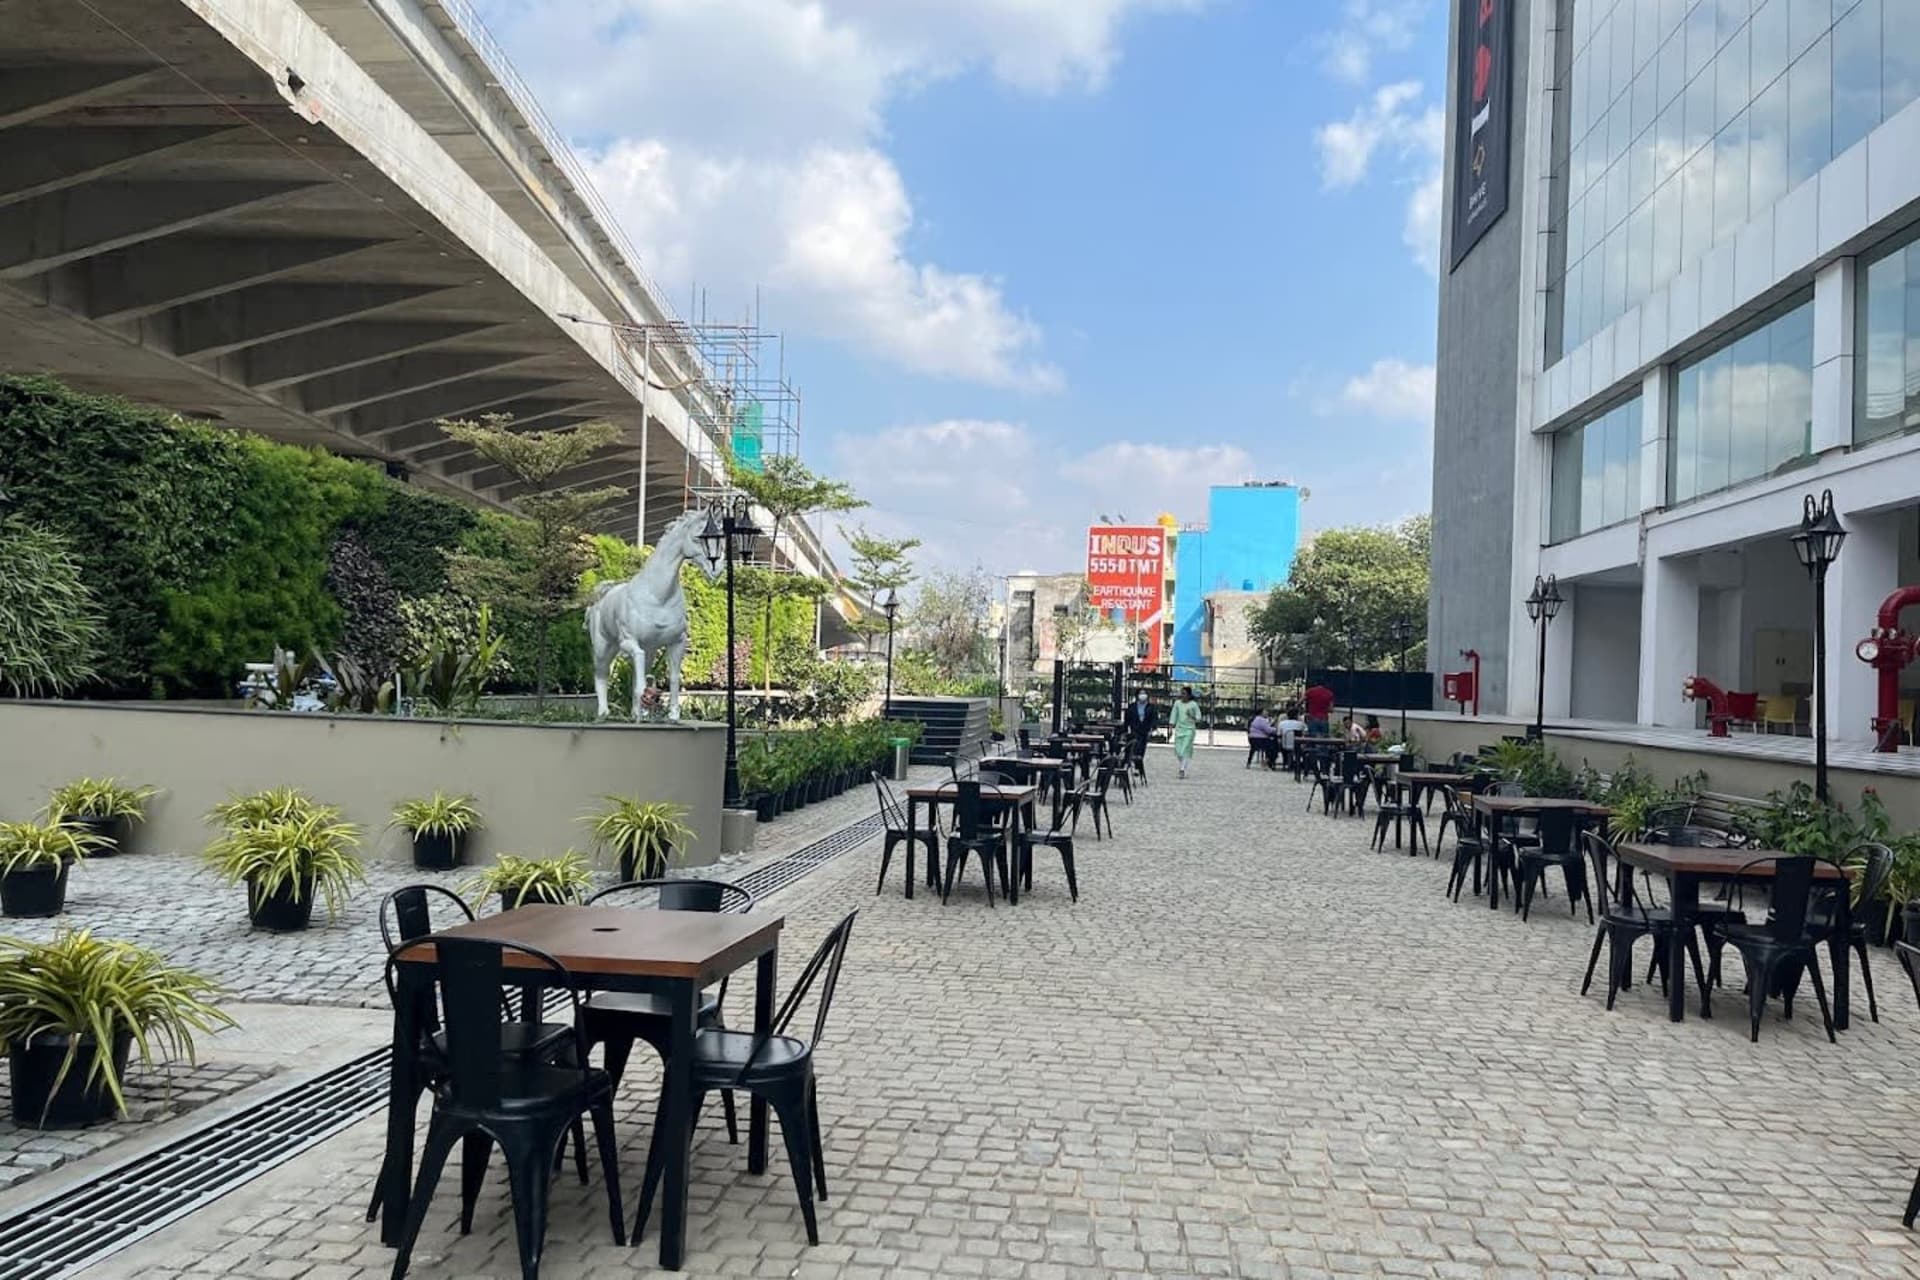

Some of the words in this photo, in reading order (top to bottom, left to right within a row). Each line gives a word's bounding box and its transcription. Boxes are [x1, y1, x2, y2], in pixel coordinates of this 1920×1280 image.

[1091, 534, 1161, 555] INDUS
[1128, 558, 1160, 575] TMT
[1093, 585, 1156, 598] EARTHQUAKE
[1101, 598, 1153, 610] RESISTANT
